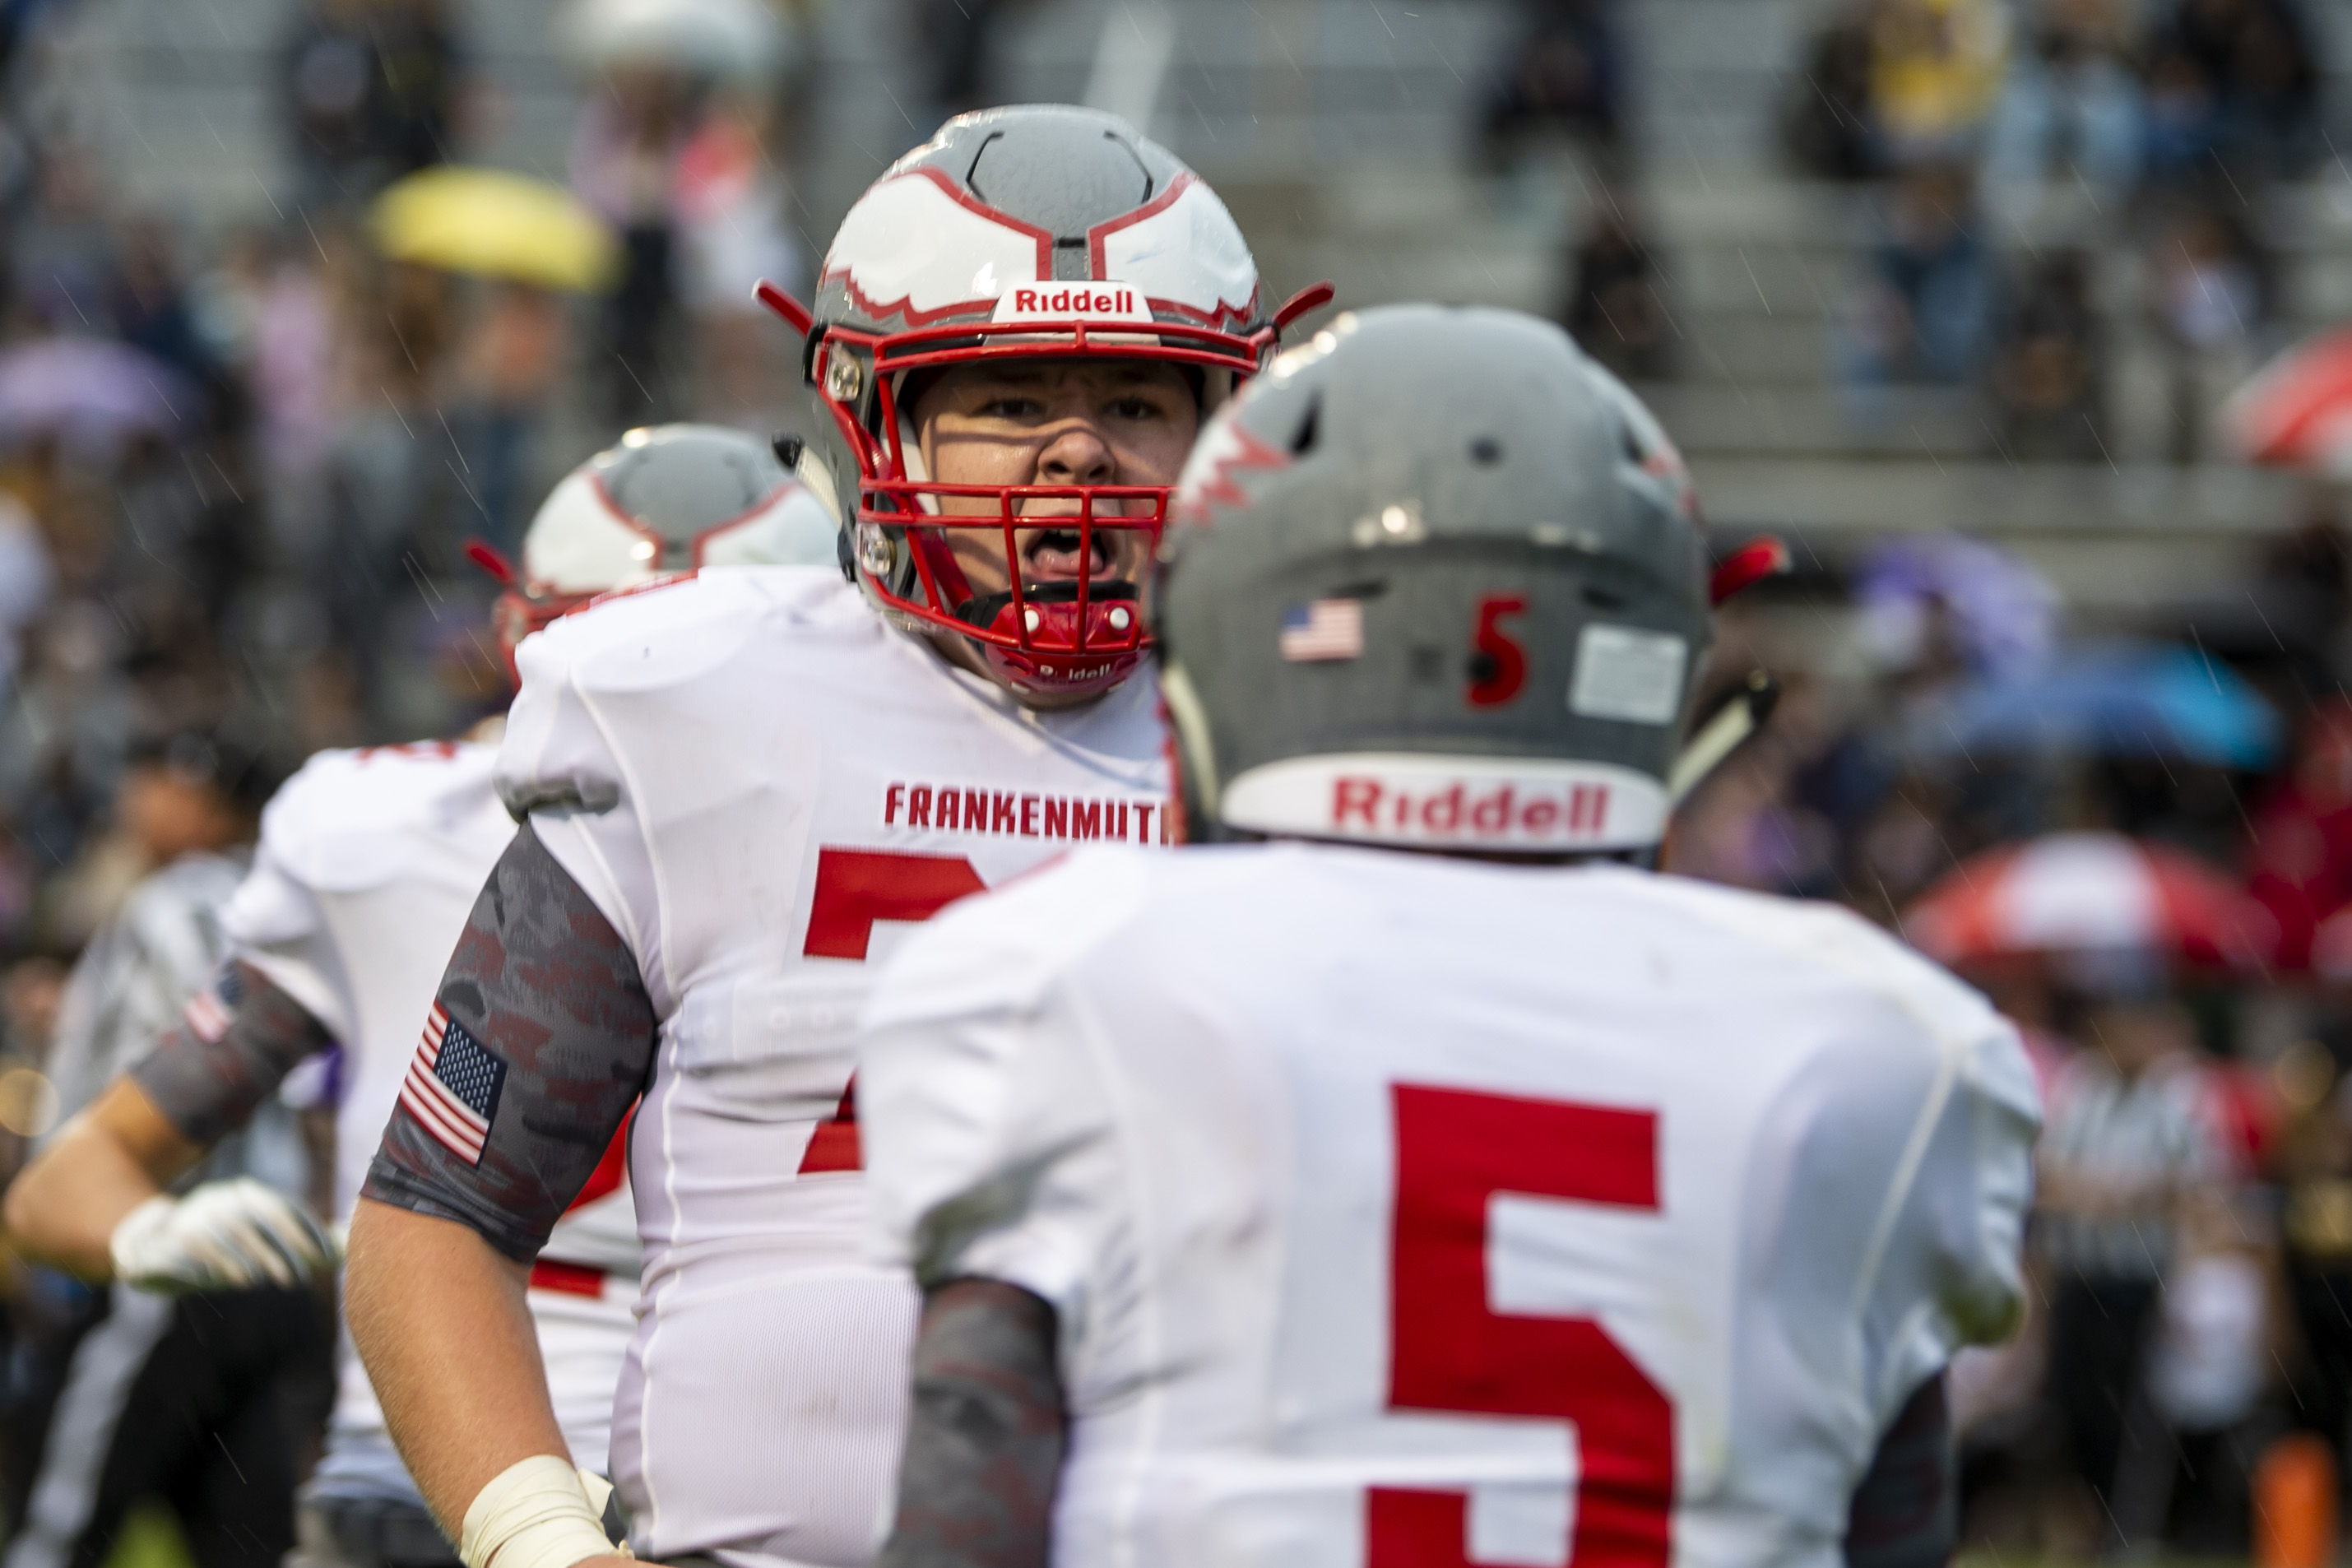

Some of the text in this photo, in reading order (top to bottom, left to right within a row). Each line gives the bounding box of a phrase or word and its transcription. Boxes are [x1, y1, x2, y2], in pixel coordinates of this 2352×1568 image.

[1015, 289, 1134, 315] Riddell
[1464, 591, 1531, 711] 5
[1331, 776, 1611, 837] Riddell
[1362, 1079, 1678, 1568] 5
